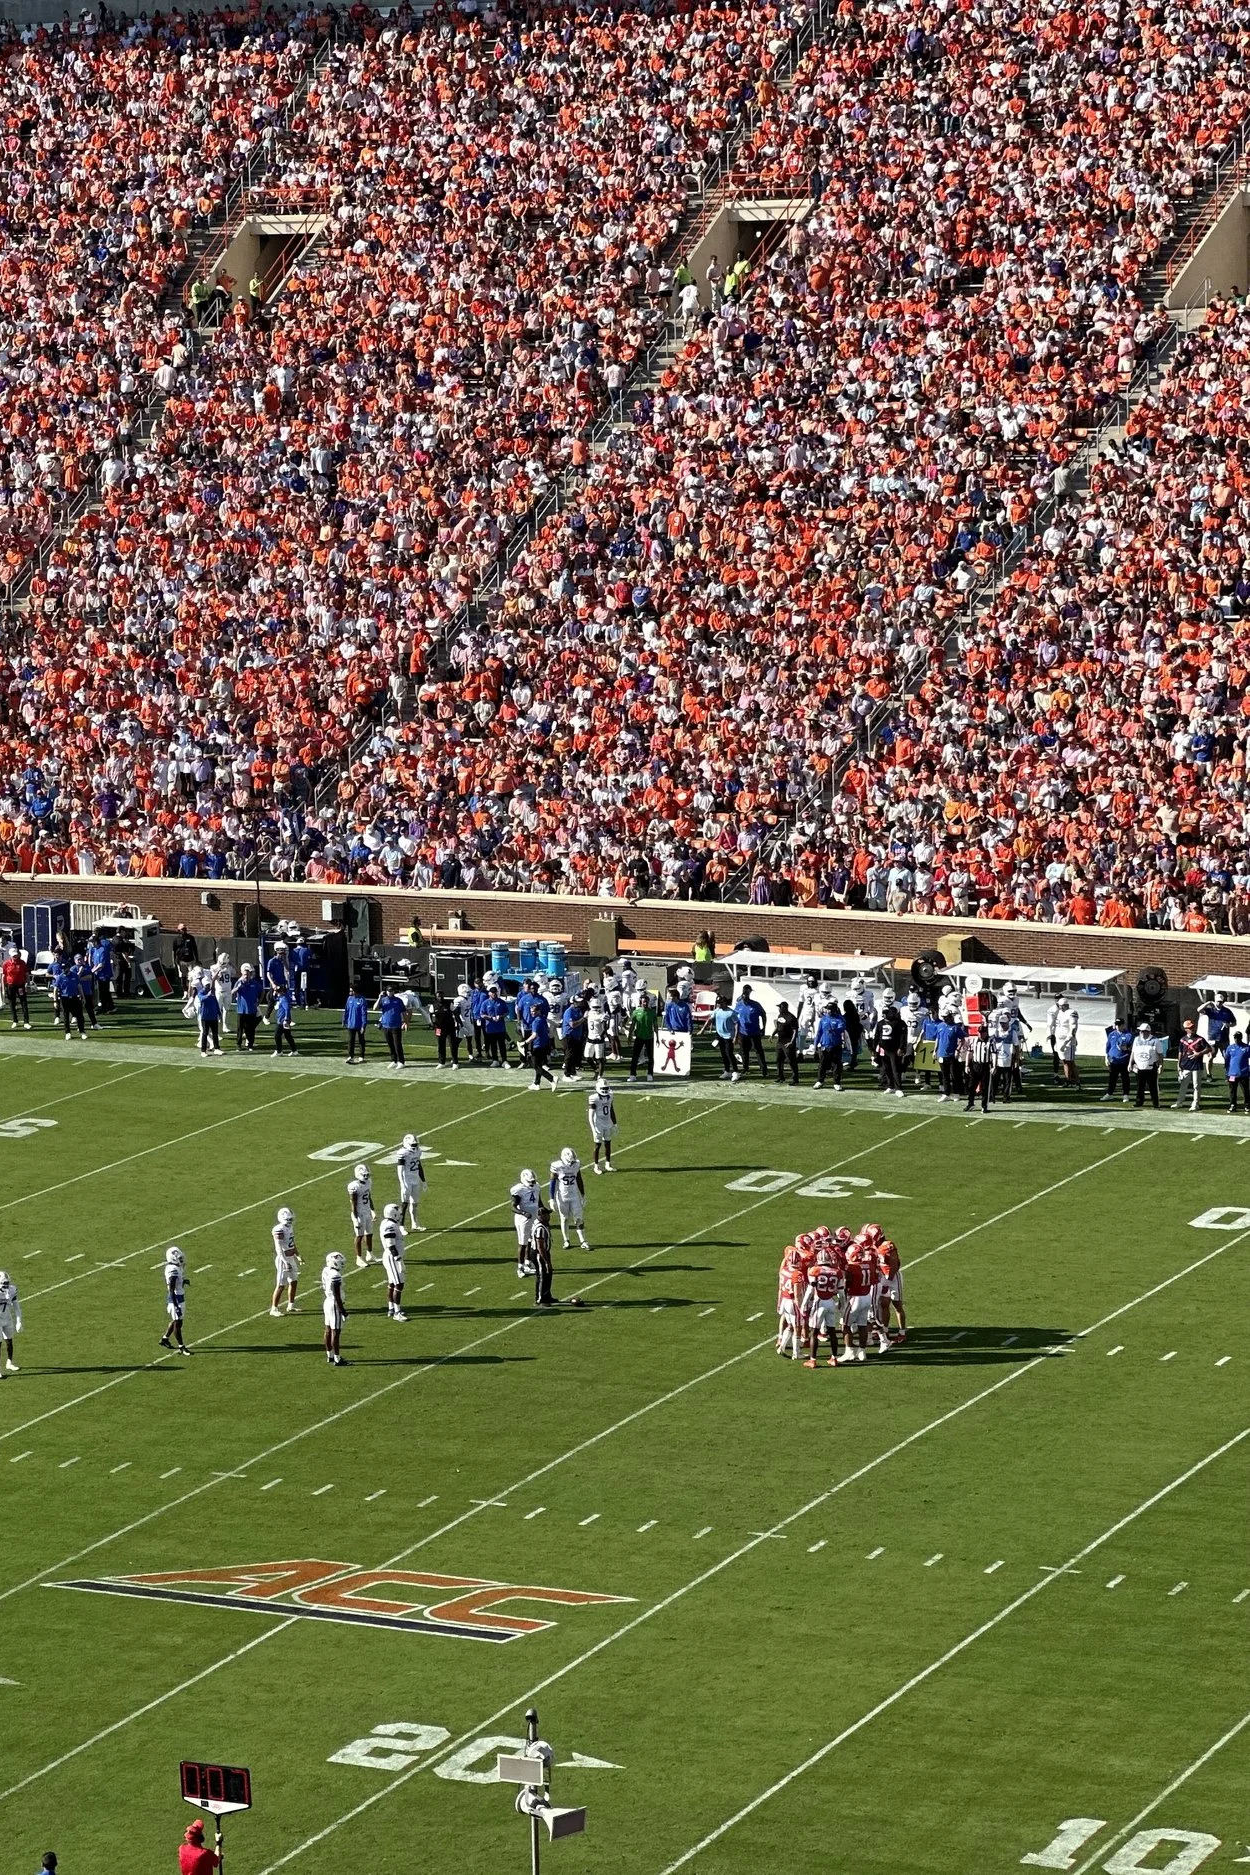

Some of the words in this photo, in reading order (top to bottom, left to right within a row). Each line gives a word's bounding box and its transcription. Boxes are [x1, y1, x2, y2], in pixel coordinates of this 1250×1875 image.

[724, 1169, 874, 1199] 30
[817, 1275, 839, 1293] 23
[97, 1557, 638, 1634] ACC
[326, 1721, 532, 1785] 20
[1019, 1818, 1223, 1875] 10
